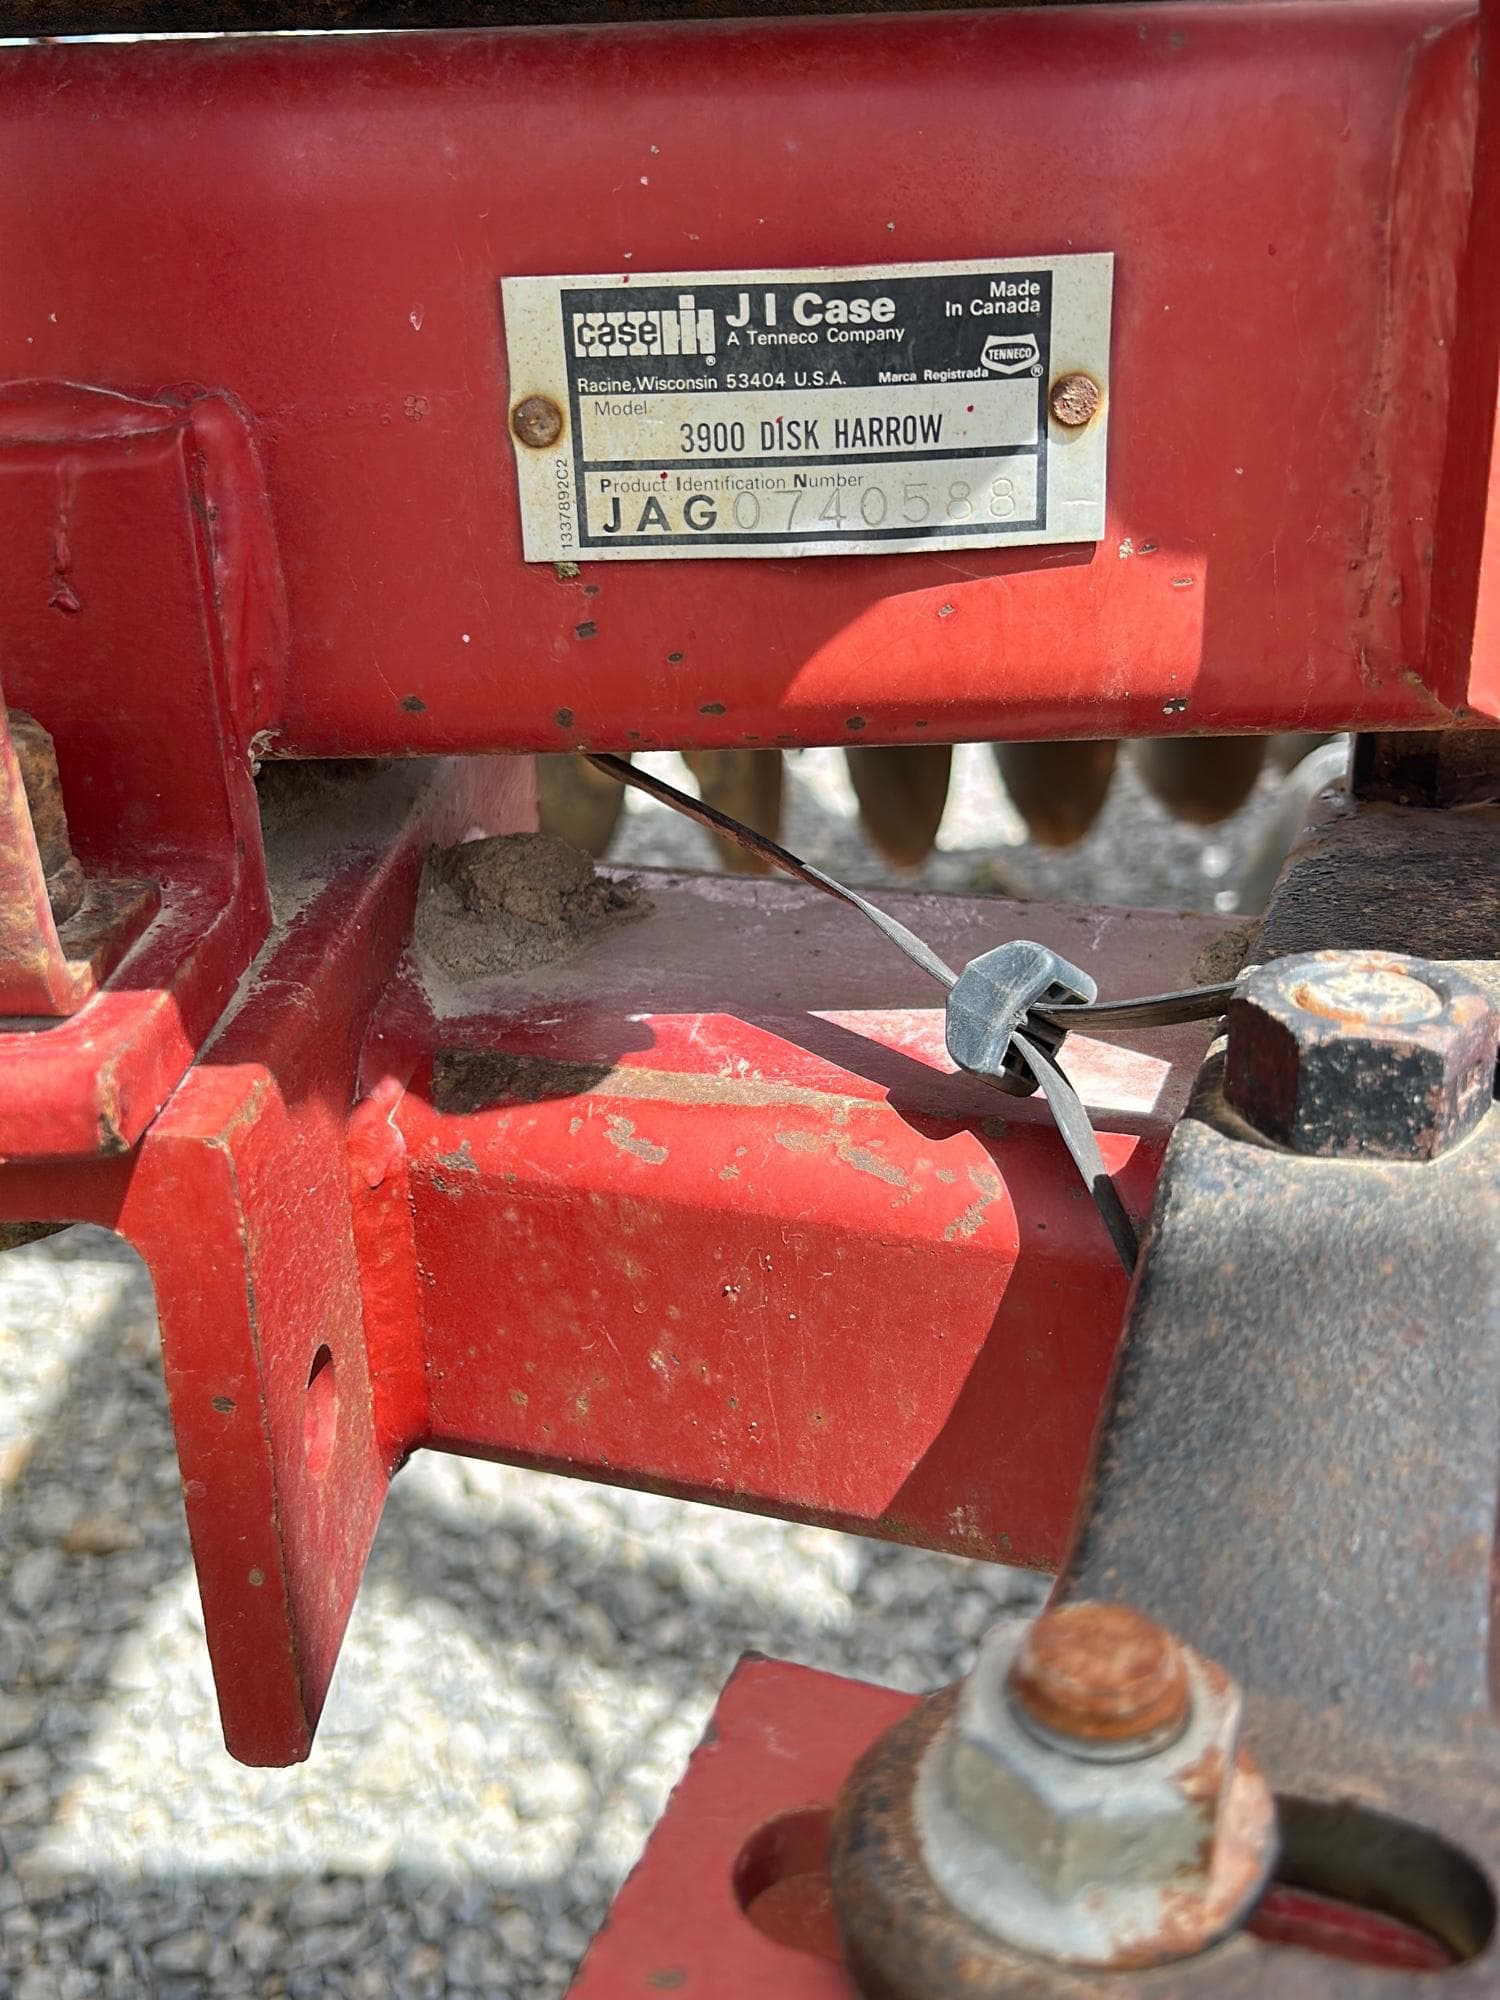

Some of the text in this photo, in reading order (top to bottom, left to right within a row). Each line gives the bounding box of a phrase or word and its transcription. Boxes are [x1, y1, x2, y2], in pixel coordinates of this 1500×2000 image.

[989, 280, 1041, 298] Made
[793, 292, 896, 327] Case
[945, 298, 1041, 317] In Canada
[726, 328, 905, 346] A Tenneco Company
[988, 347, 1033, 361] TENNECO
[726, 373, 786, 388] 53404
[794, 371, 847, 386] U.S.A.
[878, 367, 989, 384] Marca Registrada
[594, 400, 648, 416] Model
[680, 414, 943, 452] 3900 DISK HARROW
[600, 473, 864, 493] Product Identification Number
[556, 458, 574, 550] 1337892C2
